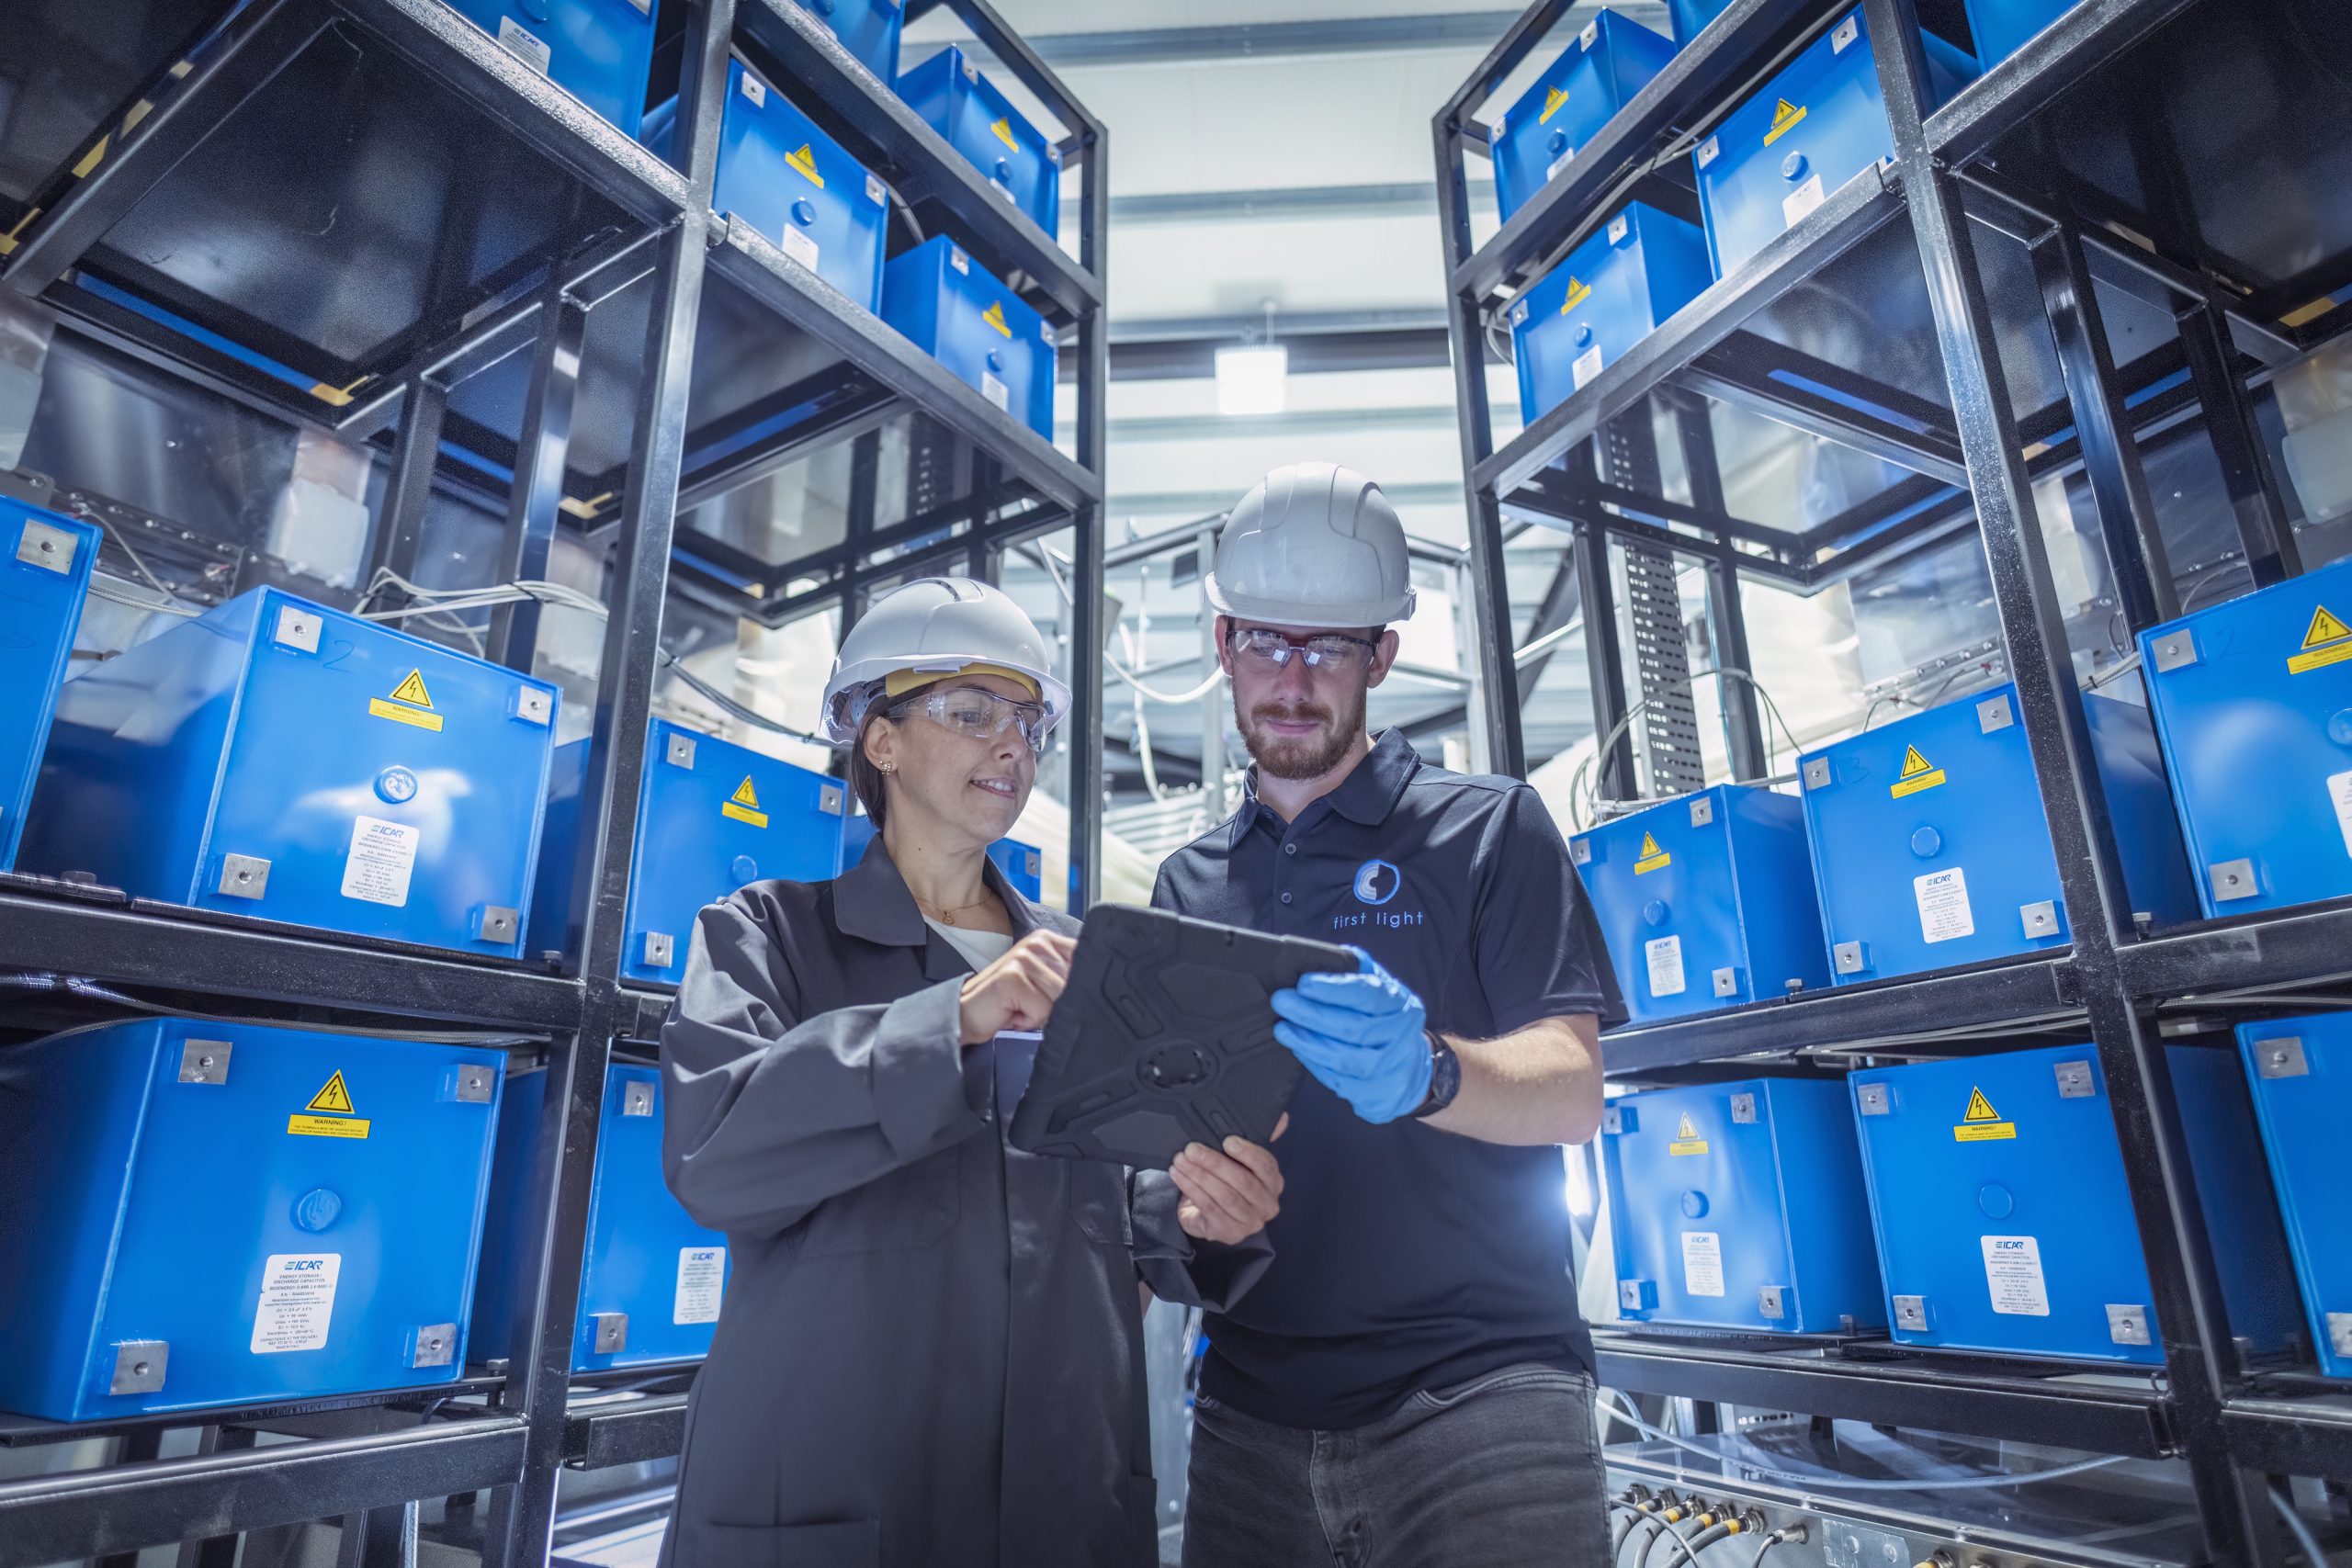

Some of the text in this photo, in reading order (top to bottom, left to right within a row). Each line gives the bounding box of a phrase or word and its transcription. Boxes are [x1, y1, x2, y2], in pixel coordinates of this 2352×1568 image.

[1334, 911, 1423, 929] first light
[2003, 1241, 2024, 1249] ICAR
[294, 1260, 323, 1270] ICAR
